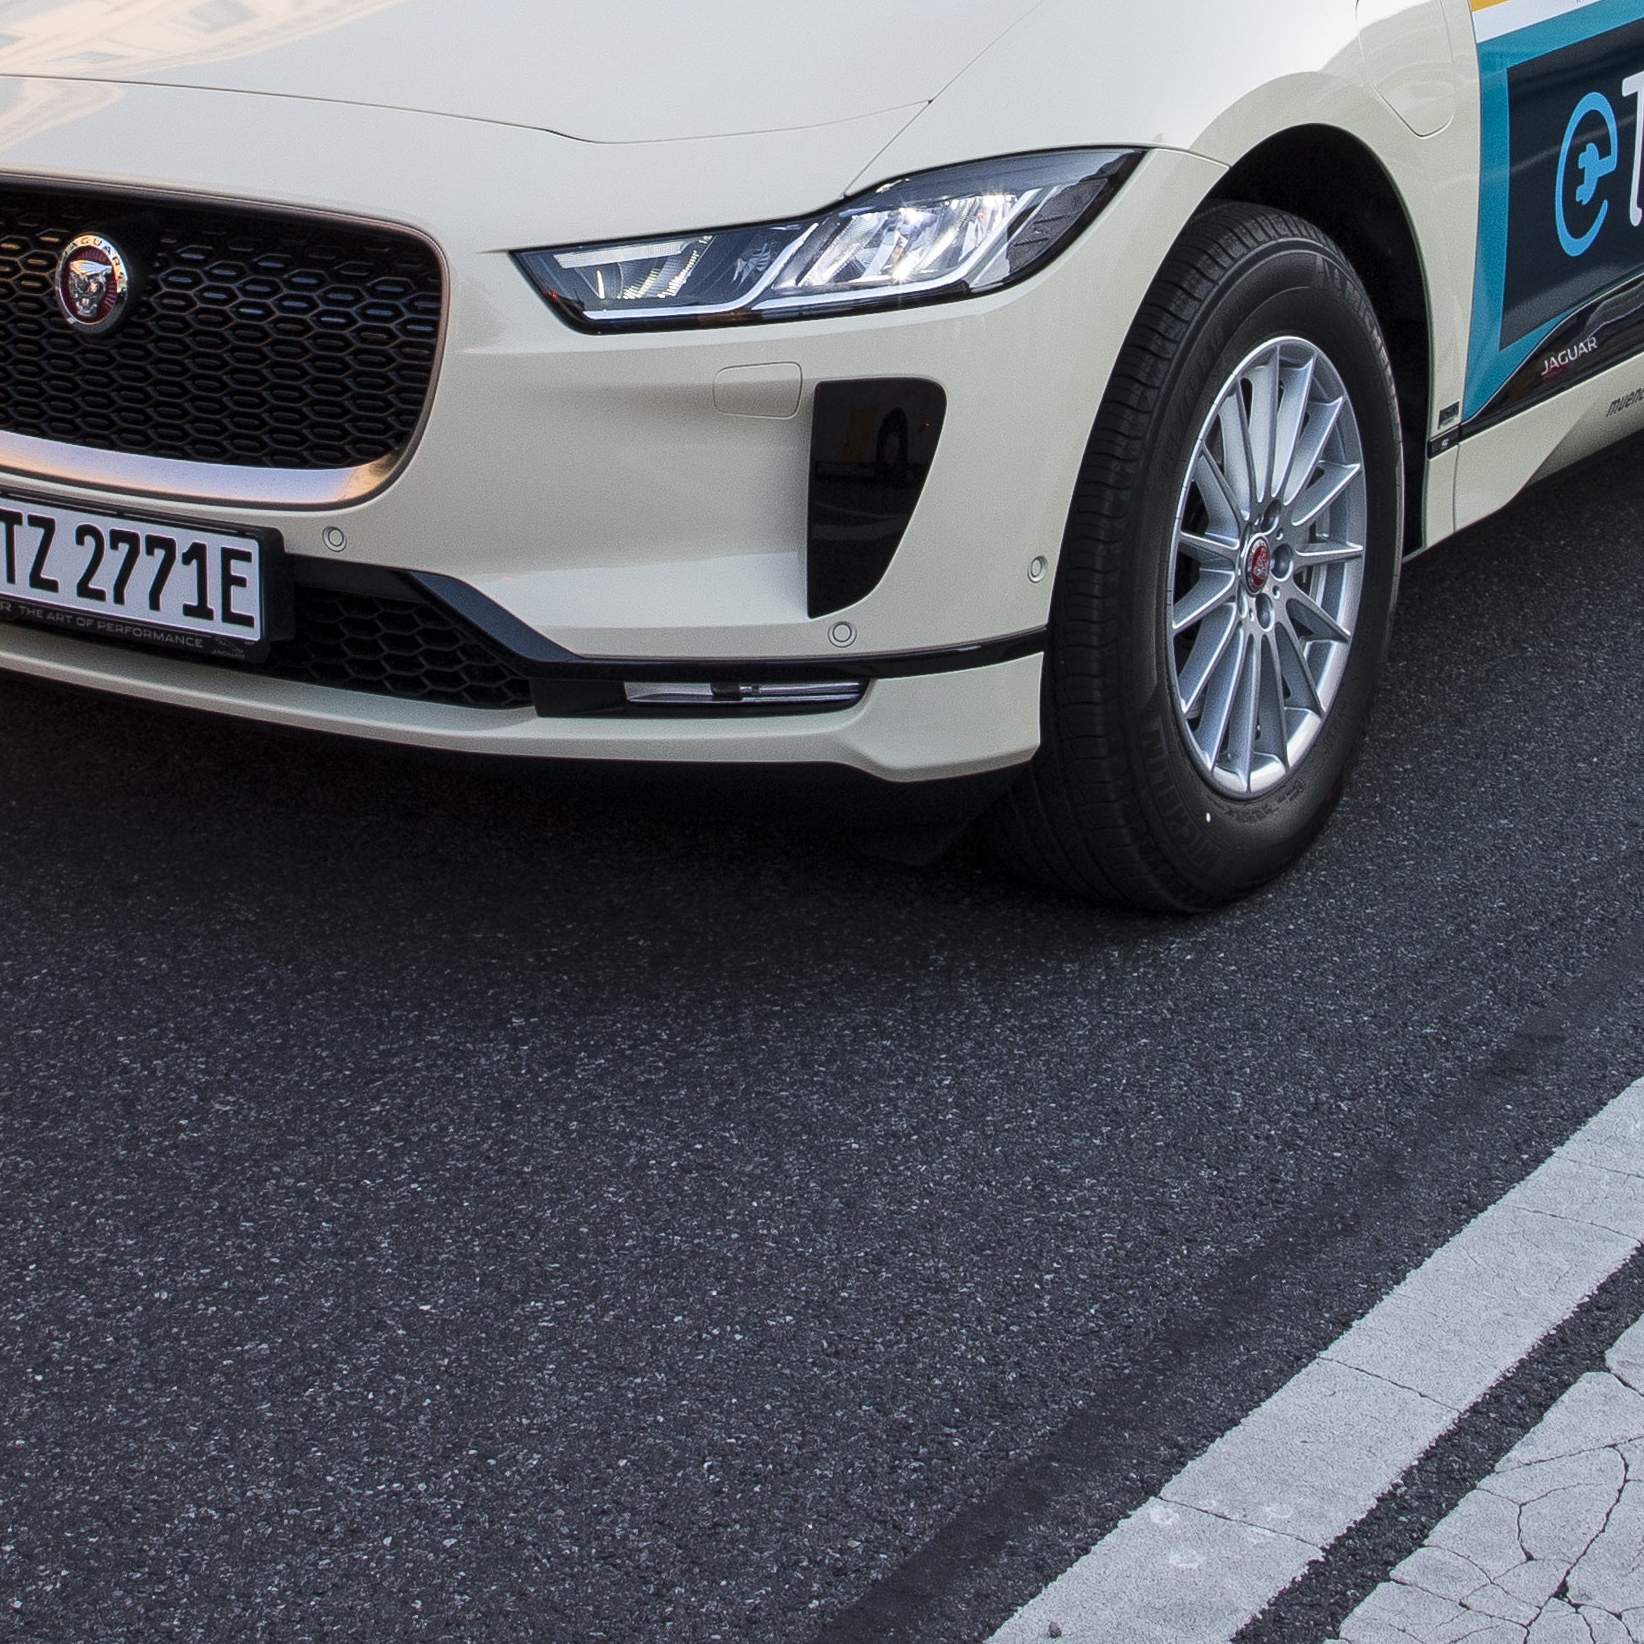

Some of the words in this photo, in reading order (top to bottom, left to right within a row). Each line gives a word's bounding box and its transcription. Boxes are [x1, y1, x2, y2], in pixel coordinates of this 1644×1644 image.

[1541, 336, 1599, 376] JAGUAR
[75, 524, 256, 628] 2771E
[18, 605, 44, 619] THE
[46, 613, 73, 624] ART
[76, 617, 94, 628] OF
[97, 621, 204, 648] PERFORMANCE
